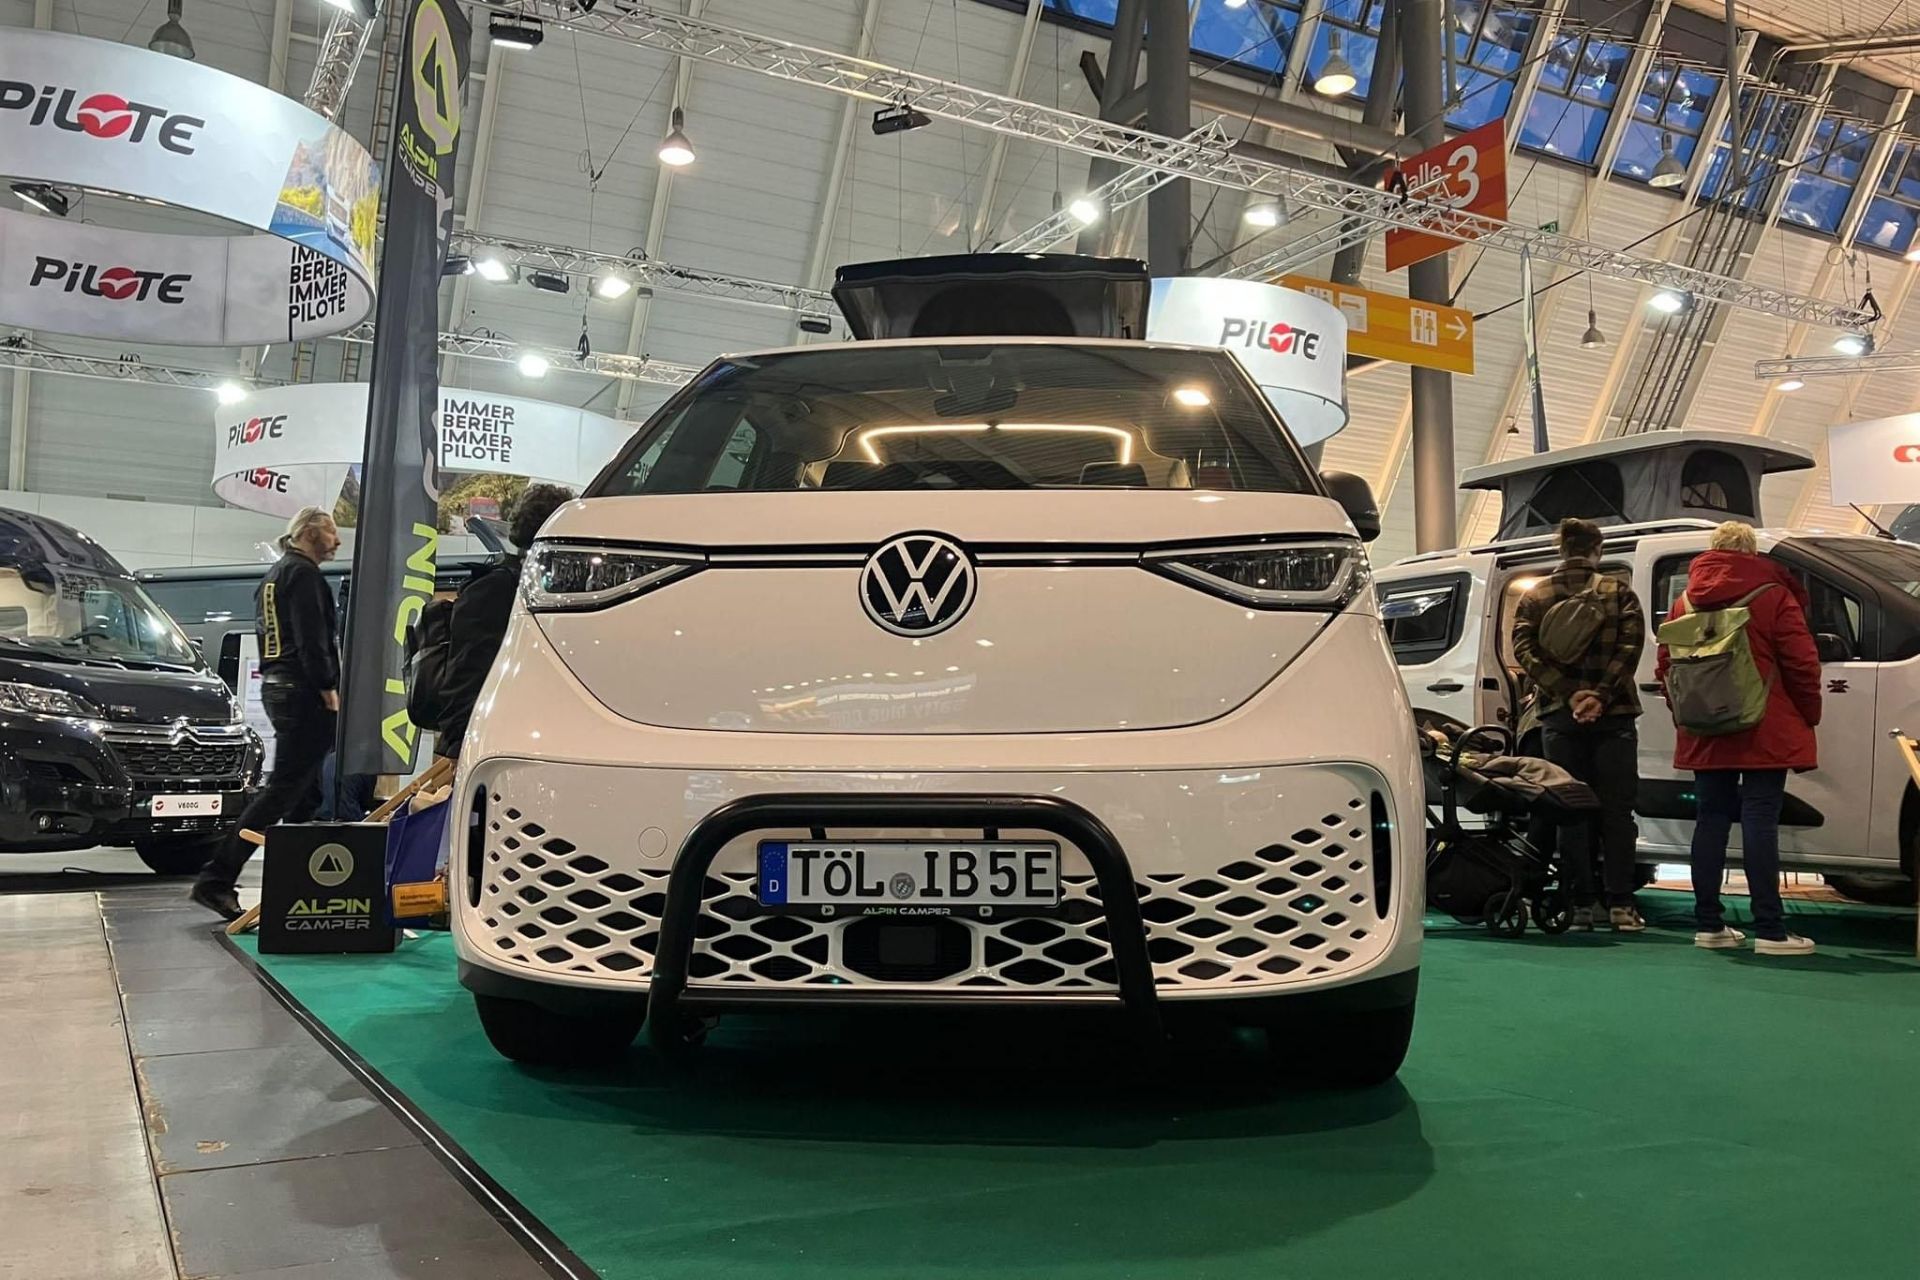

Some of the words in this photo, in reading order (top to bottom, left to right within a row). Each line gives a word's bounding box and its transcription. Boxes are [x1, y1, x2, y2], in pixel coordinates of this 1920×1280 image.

[1447, 145, 1479, 209] 3
[290, 259, 344, 284] BEREI
[289, 272, 347, 304] IMMER
[289, 292, 346, 341] PILOTE
[443, 398, 515, 421] IMMER
[443, 414, 515, 435] BEREIT
[443, 428, 513, 450] IMMER
[442, 443, 511, 467] PILOTE
[769, 879, 780, 893] D
[287, 898, 371, 915] ALPIN
[863, 907, 897, 915] ALPIN
[900, 907, 951, 915] CAMPER
[285, 919, 371, 931] CAMPER
